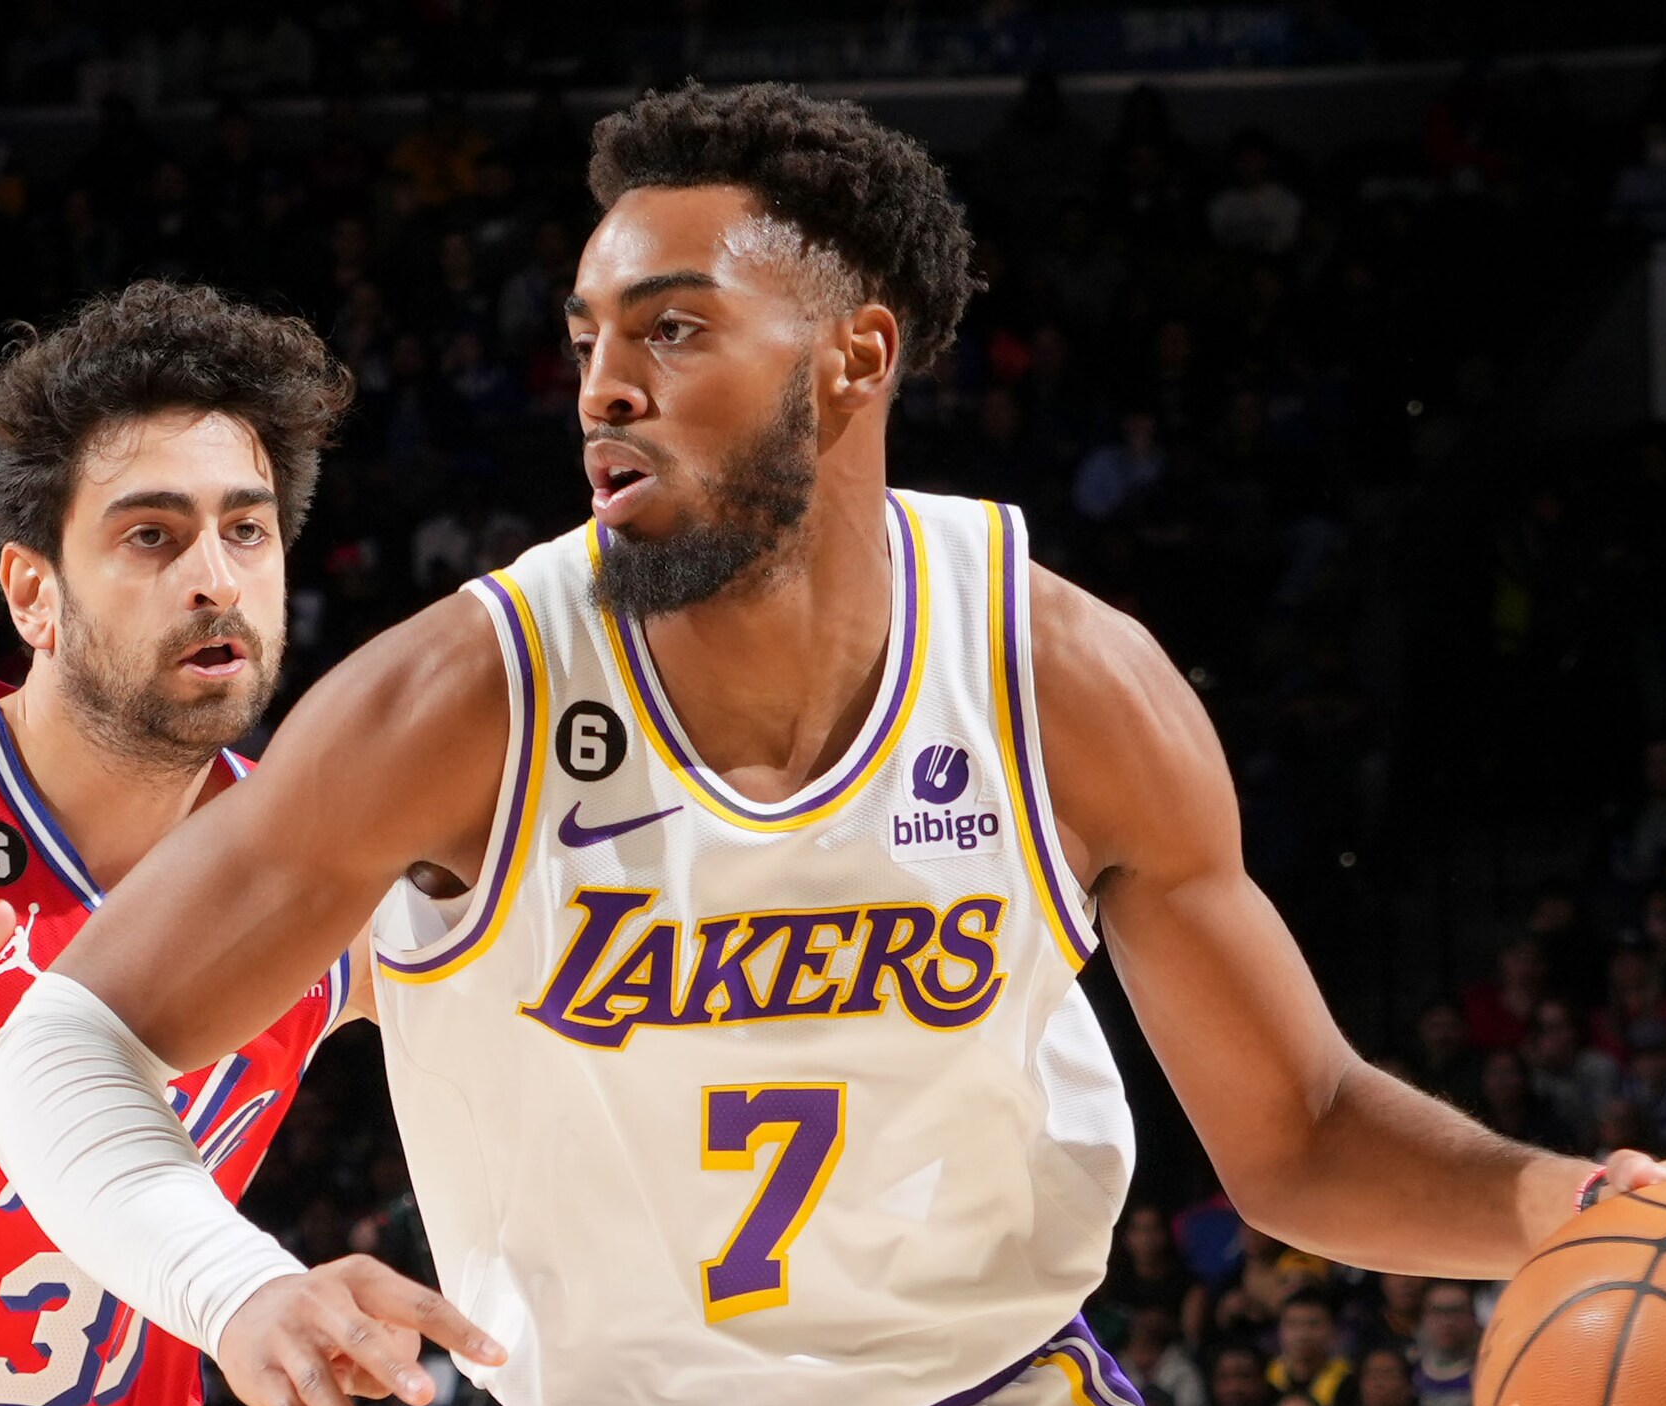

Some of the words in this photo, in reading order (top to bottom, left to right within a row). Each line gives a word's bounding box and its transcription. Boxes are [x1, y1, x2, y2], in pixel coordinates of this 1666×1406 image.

[570, 713, 608, 772] 6
[894, 809, 999, 850] bibigo
[515, 885, 1009, 1053] LAKERS
[700, 1081, 847, 1325] 7
